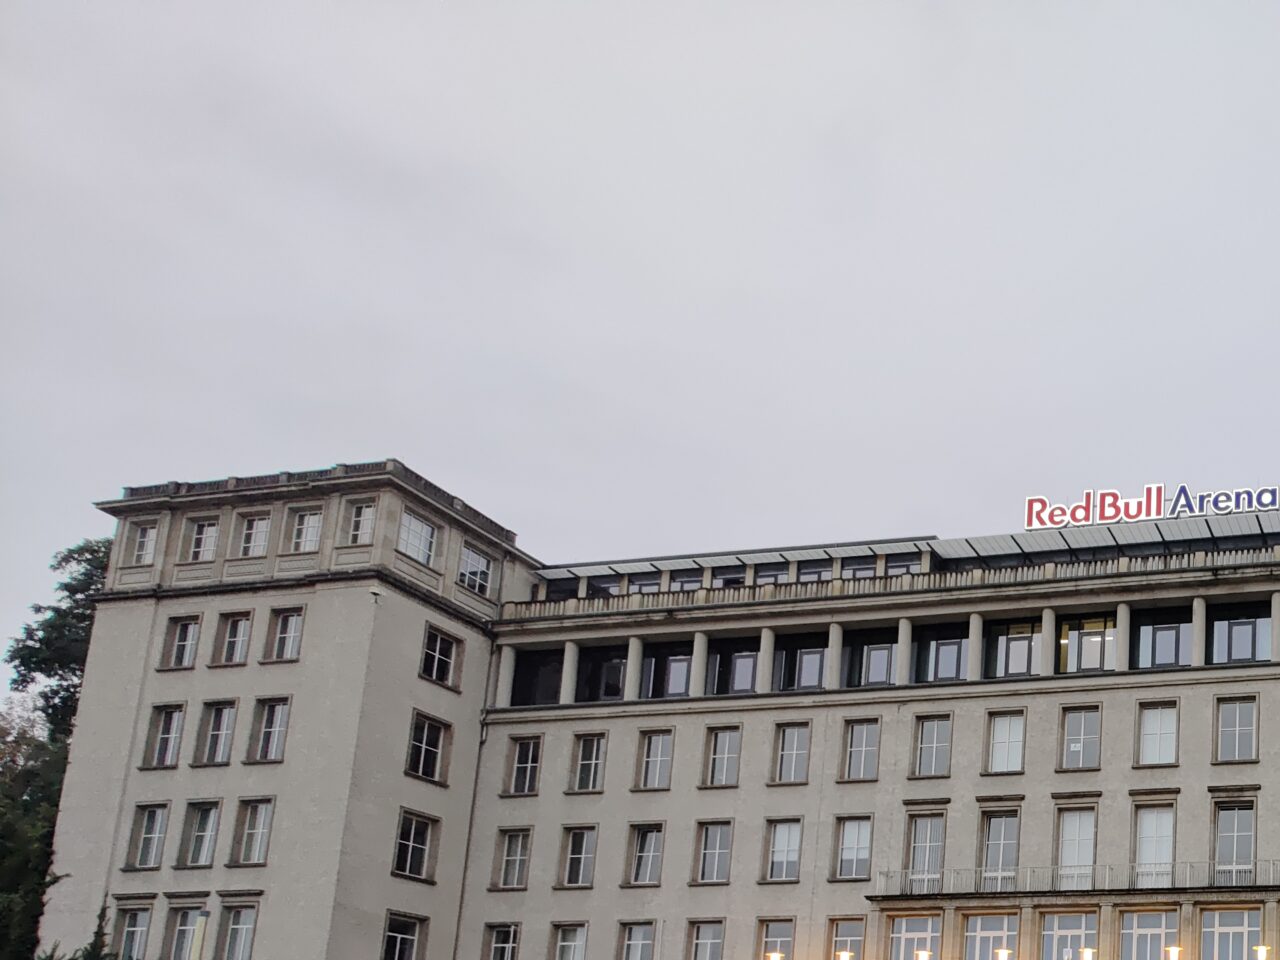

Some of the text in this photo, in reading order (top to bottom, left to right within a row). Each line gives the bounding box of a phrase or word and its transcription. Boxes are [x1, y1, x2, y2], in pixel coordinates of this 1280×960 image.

[1025, 484, 1279, 528] Red Bull Arena
